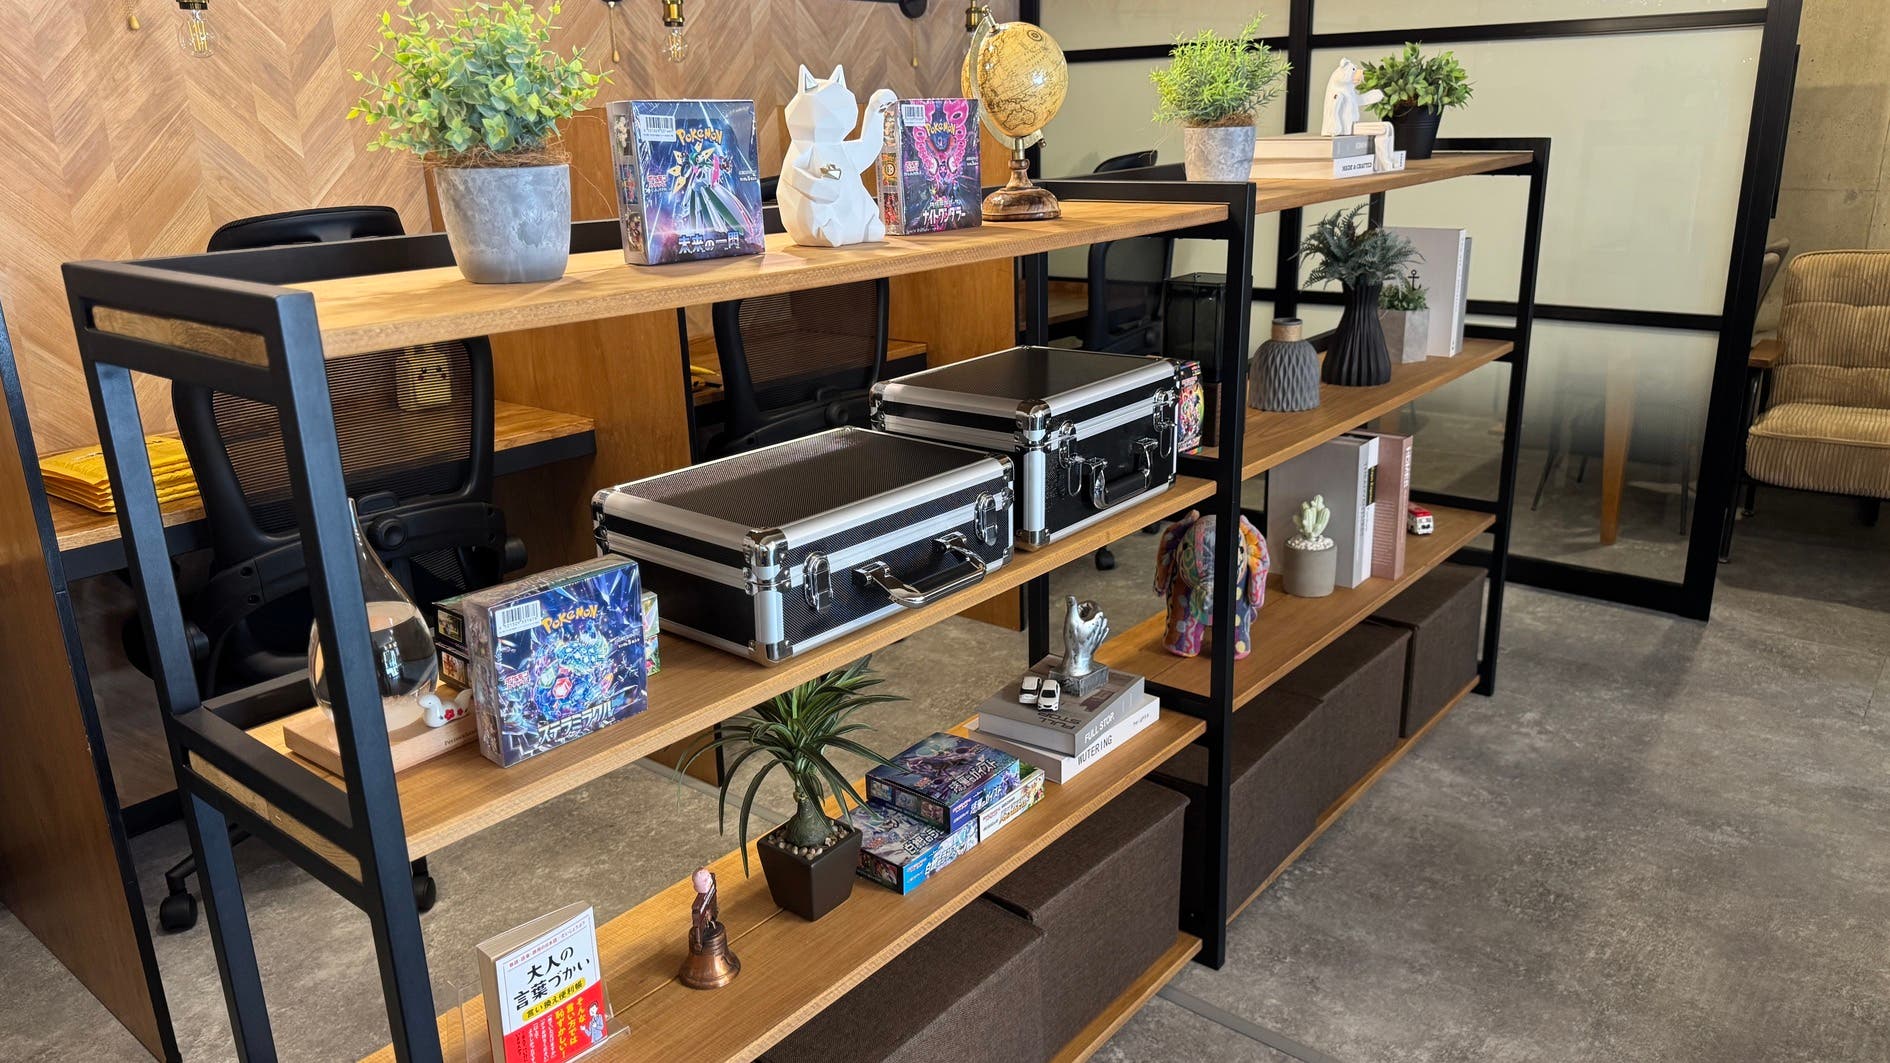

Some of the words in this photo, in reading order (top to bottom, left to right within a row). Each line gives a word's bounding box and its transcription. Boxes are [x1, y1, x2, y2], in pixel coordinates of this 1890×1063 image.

[678, 231, 741, 255] 未来の一閃
[538, 700, 614, 744] ステラミラクル
[1084, 726, 1100, 744] FULL
[1099, 711, 1116, 730] STOP
[513, 957, 591, 1011] 言葉づかい
[527, 946, 575, 985] 大人の
[526, 979, 585, 1019] 言い換え便利帳
[576, 998, 587, 1023] そんな
[566, 1003, 579, 1046] 言い方では
